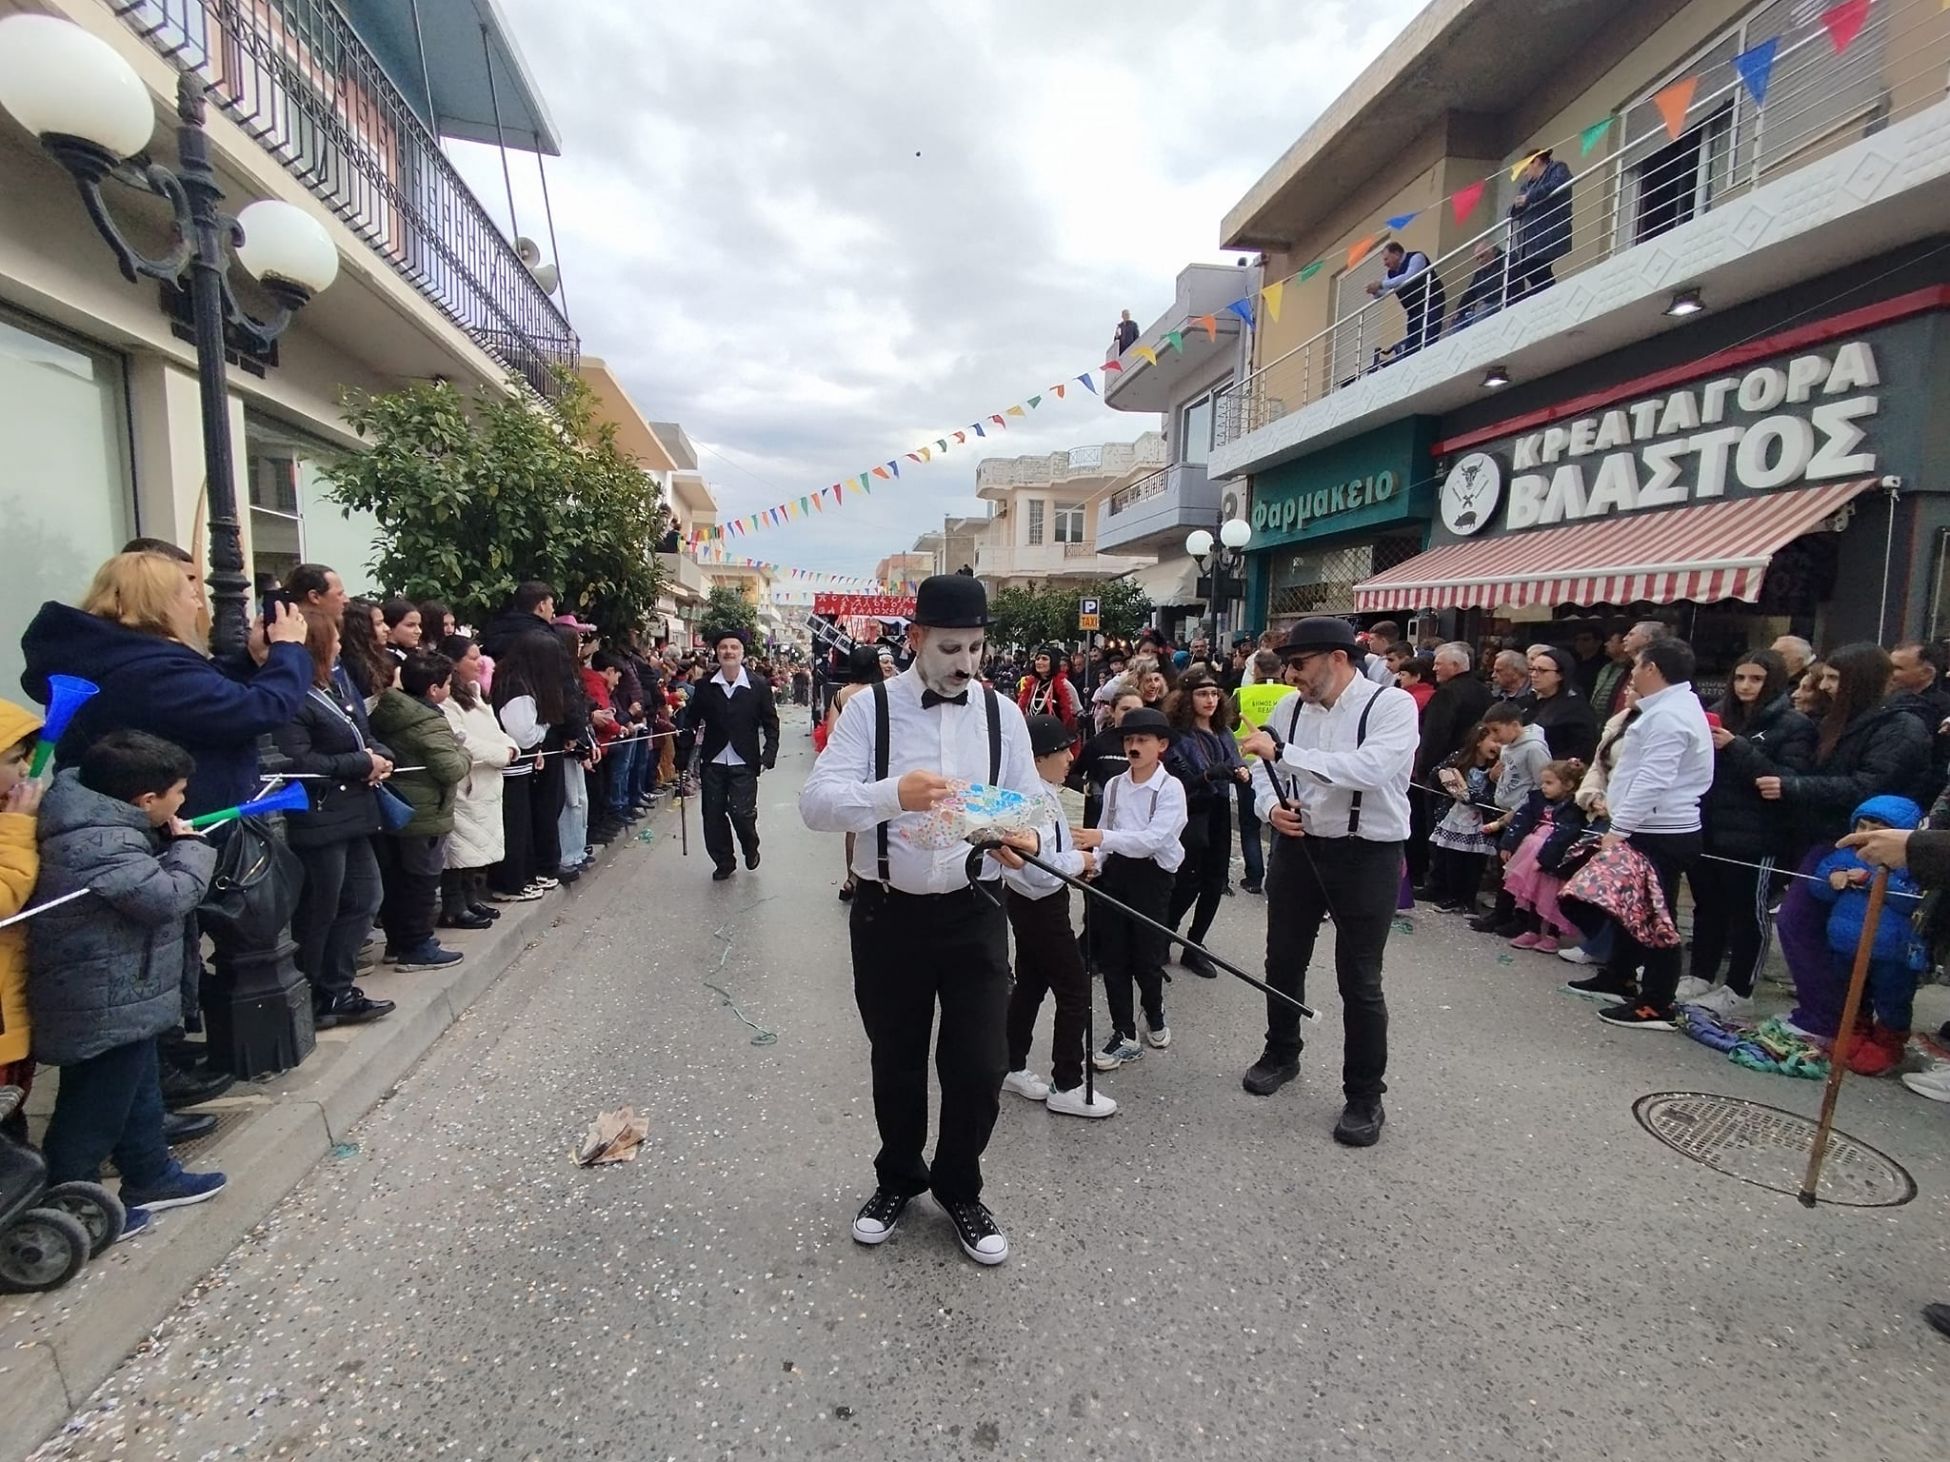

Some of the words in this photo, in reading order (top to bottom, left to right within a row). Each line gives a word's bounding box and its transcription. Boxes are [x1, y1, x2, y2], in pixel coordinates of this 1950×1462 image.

[1514, 342, 1879, 470] ΚΡΕΑΤΑΓΟΡΑ
[1507, 396, 1878, 530] ΒΛΑΣΤΟΣ
[1082, 616, 1098, 627] TAXI
[1084, 601, 1096, 613] P
